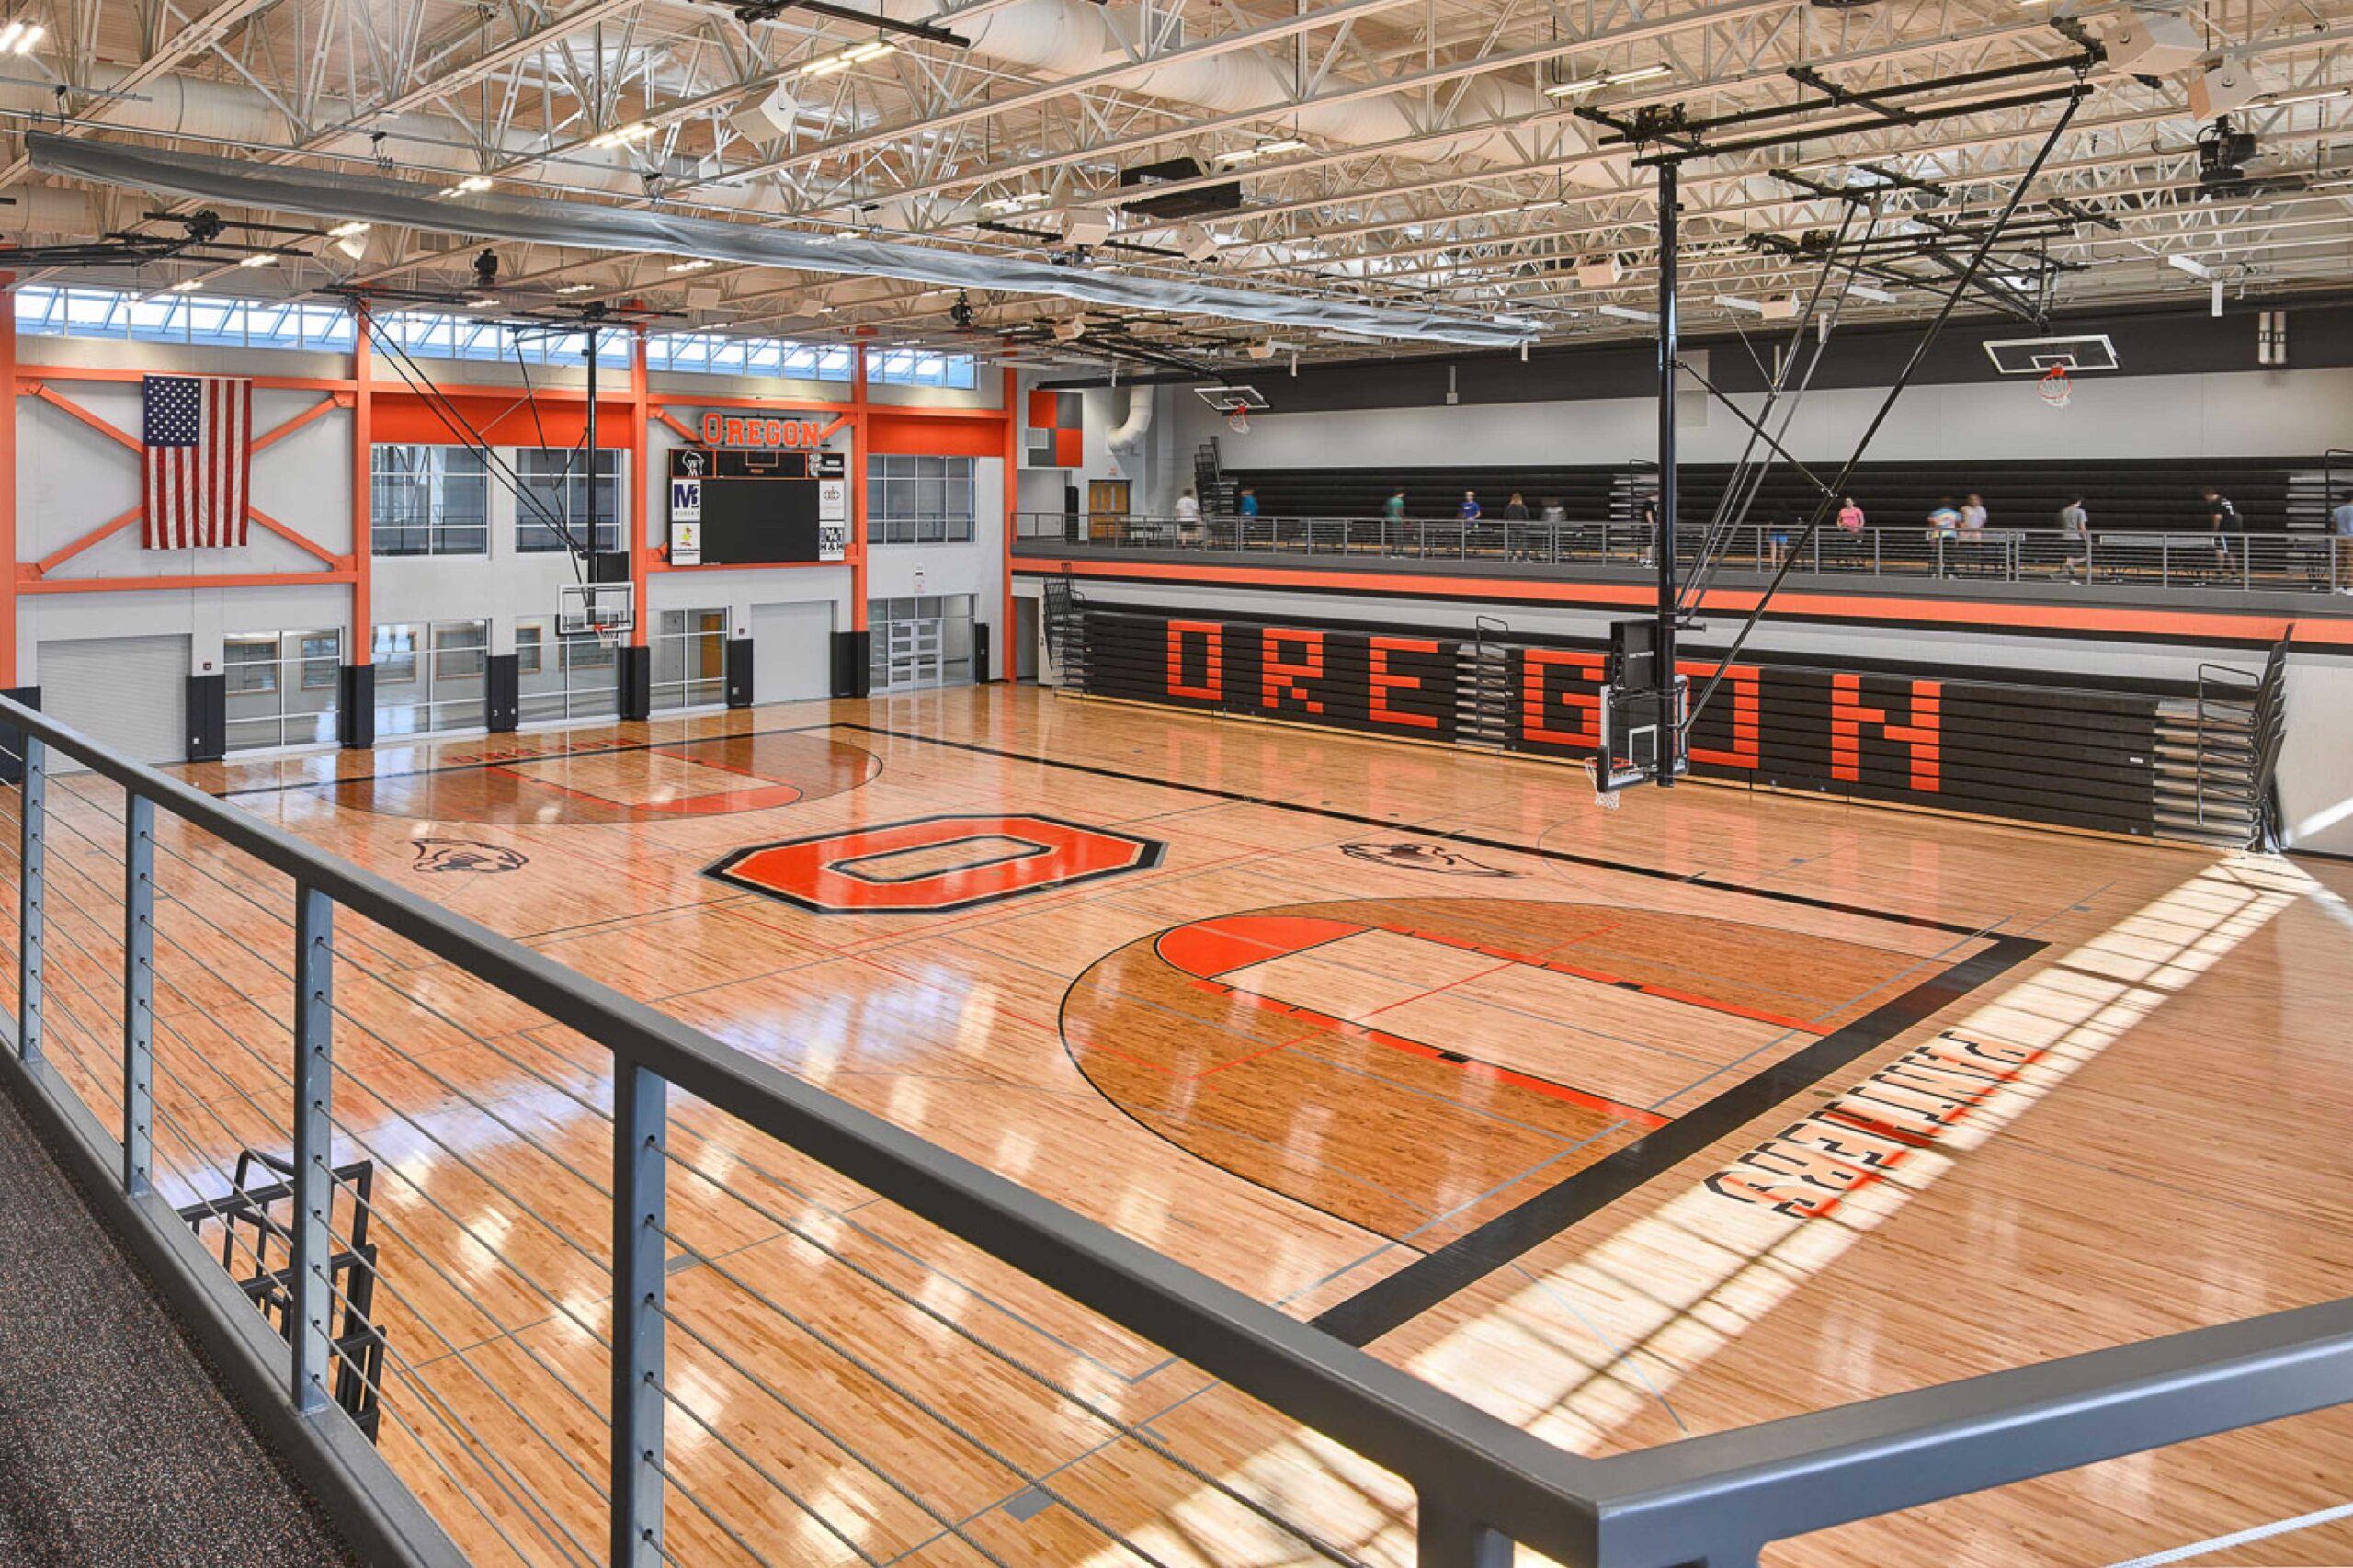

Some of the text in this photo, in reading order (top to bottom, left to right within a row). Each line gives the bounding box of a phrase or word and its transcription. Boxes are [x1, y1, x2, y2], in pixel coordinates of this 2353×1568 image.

[704, 412, 820, 447] OREGON
[1167, 619, 1940, 792] OREGON
[1703, 1029, 2049, 1220] PANTHERS
